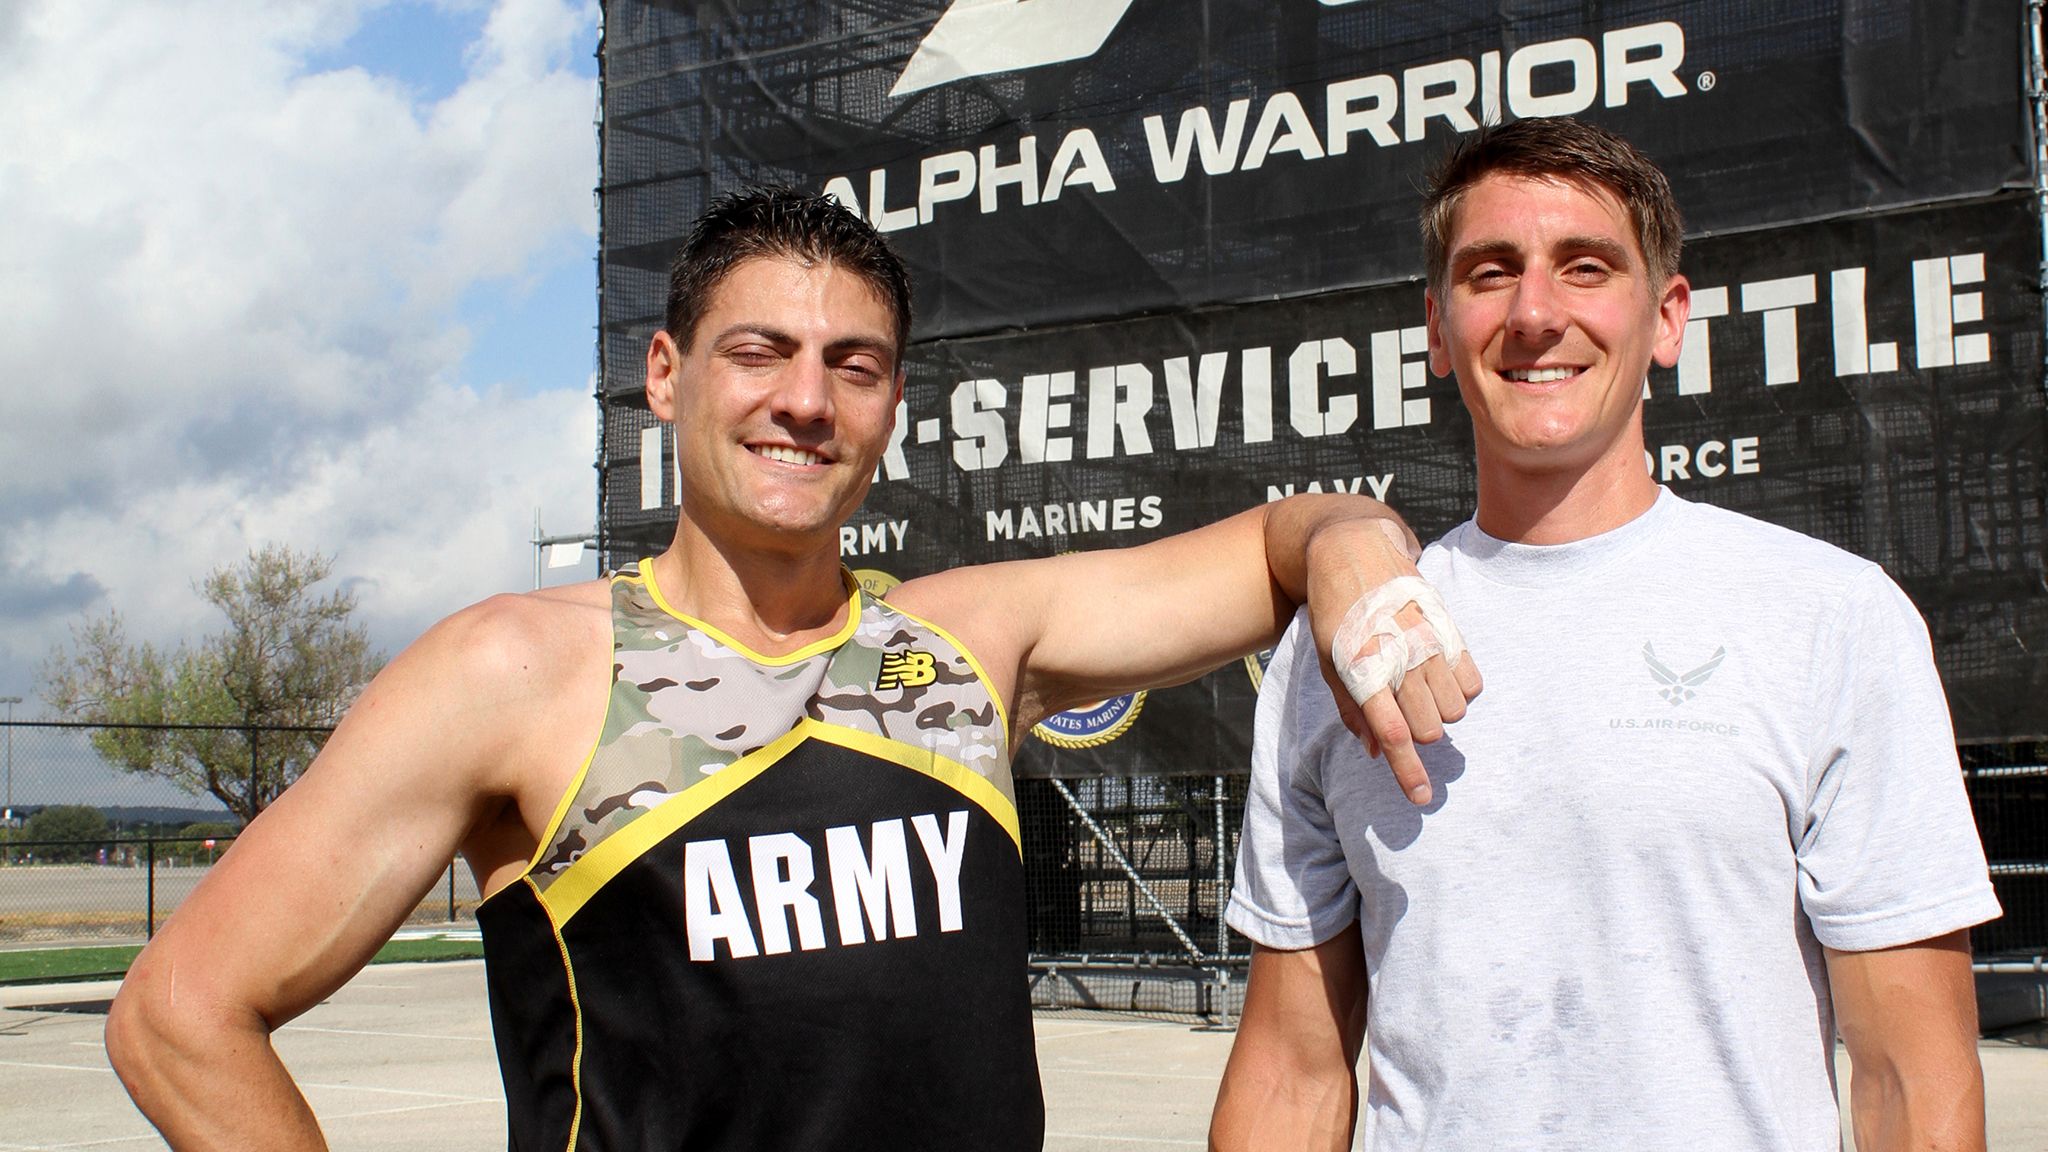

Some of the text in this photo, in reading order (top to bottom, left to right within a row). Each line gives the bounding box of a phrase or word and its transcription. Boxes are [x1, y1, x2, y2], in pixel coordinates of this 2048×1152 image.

[822, 128, 1117, 234] ALPHA
[1143, 20, 1688, 184] WARRIOR
[640, 252, 1991, 511] I-SERVICE TTLE
[1644, 436, 1761, 483] RCE
[838, 519, 909, 556] RMY
[986, 496, 1164, 542] MARINES
[1048, 697, 1127, 730] TATES MARINE
[1608, 718, 1741, 737] U.S. AIR FORCE
[684, 810, 970, 963] ARMY
